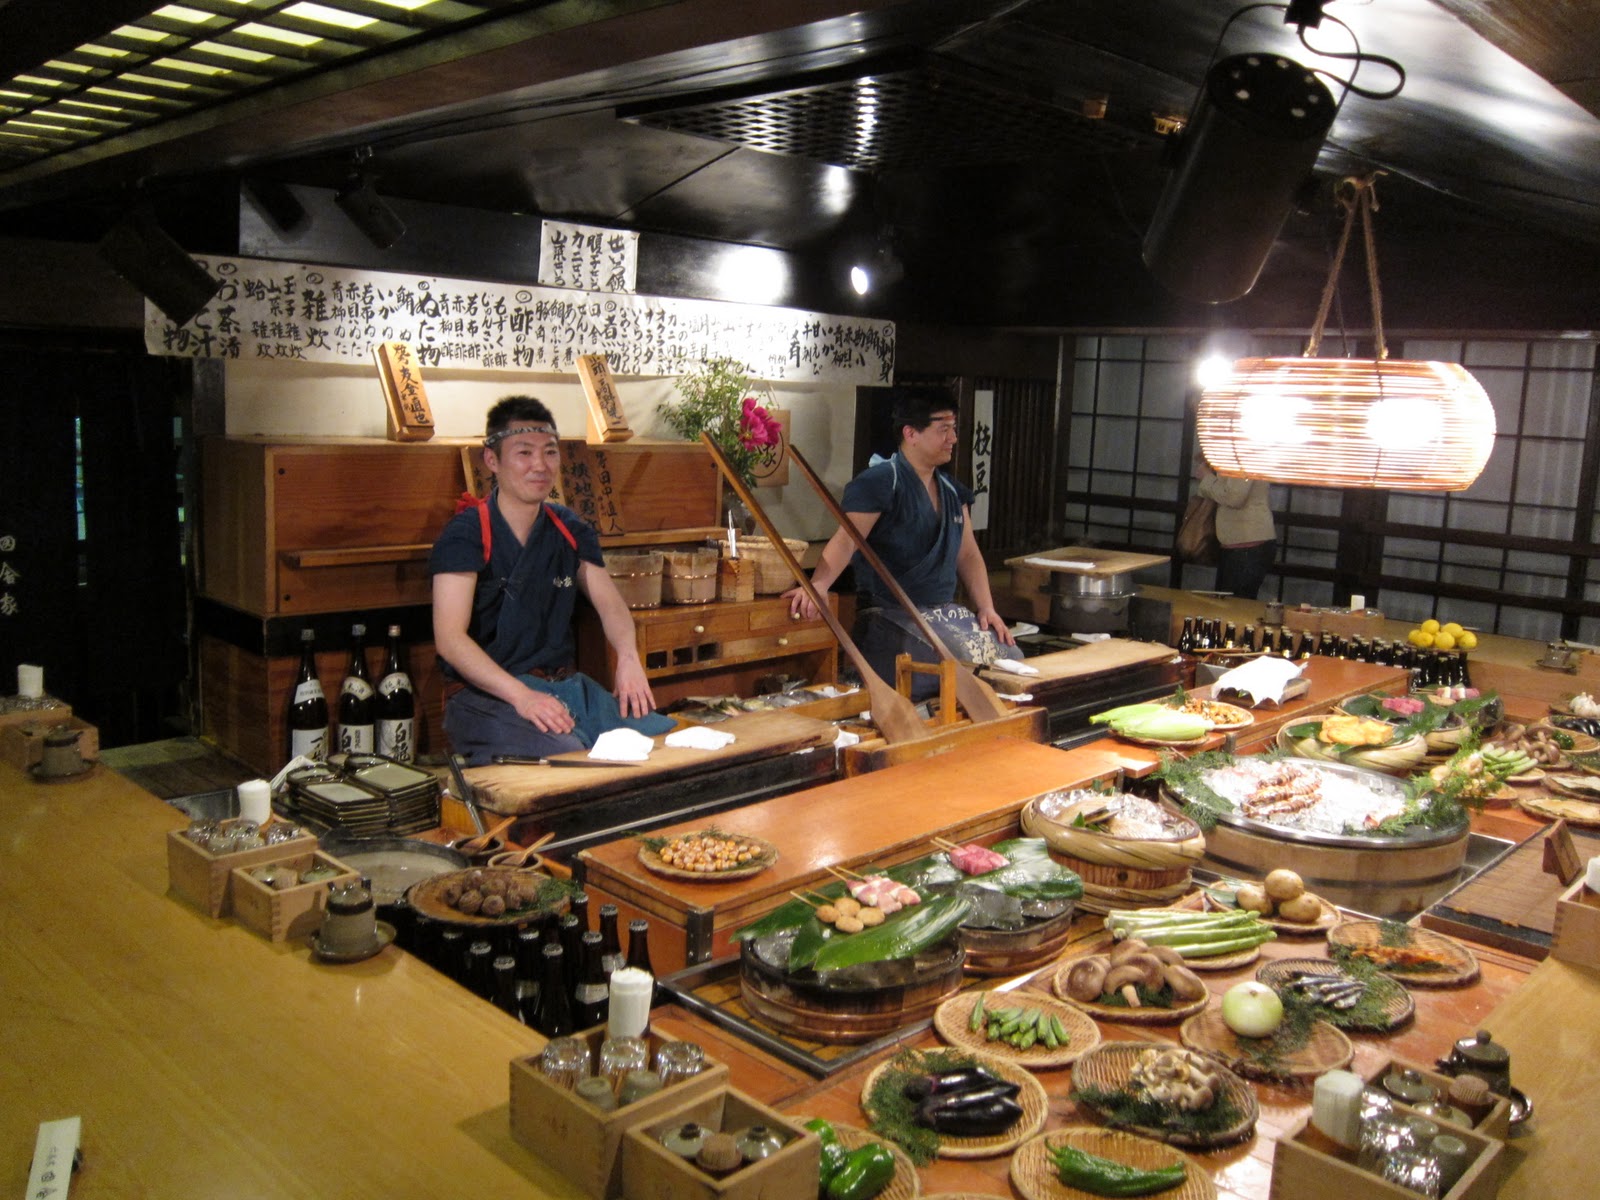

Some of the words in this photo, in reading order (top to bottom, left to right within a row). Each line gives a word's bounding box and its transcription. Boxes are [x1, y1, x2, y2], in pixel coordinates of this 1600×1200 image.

[300, 288, 331, 351] 雑炊
[415, 291, 441, 367] ぬた物
[452, 295, 466, 360] 赤貝酢
[465, 293, 480, 359] 若布酢
[493, 296, 508, 367] もずく酢
[510, 306, 534, 367] 酢の物
[588, 303, 602, 354] 田舎
[643, 308, 656, 364] サラダ
[821, 326, 835, 357] いか
[973, 421, 991, 495] 枝豆
